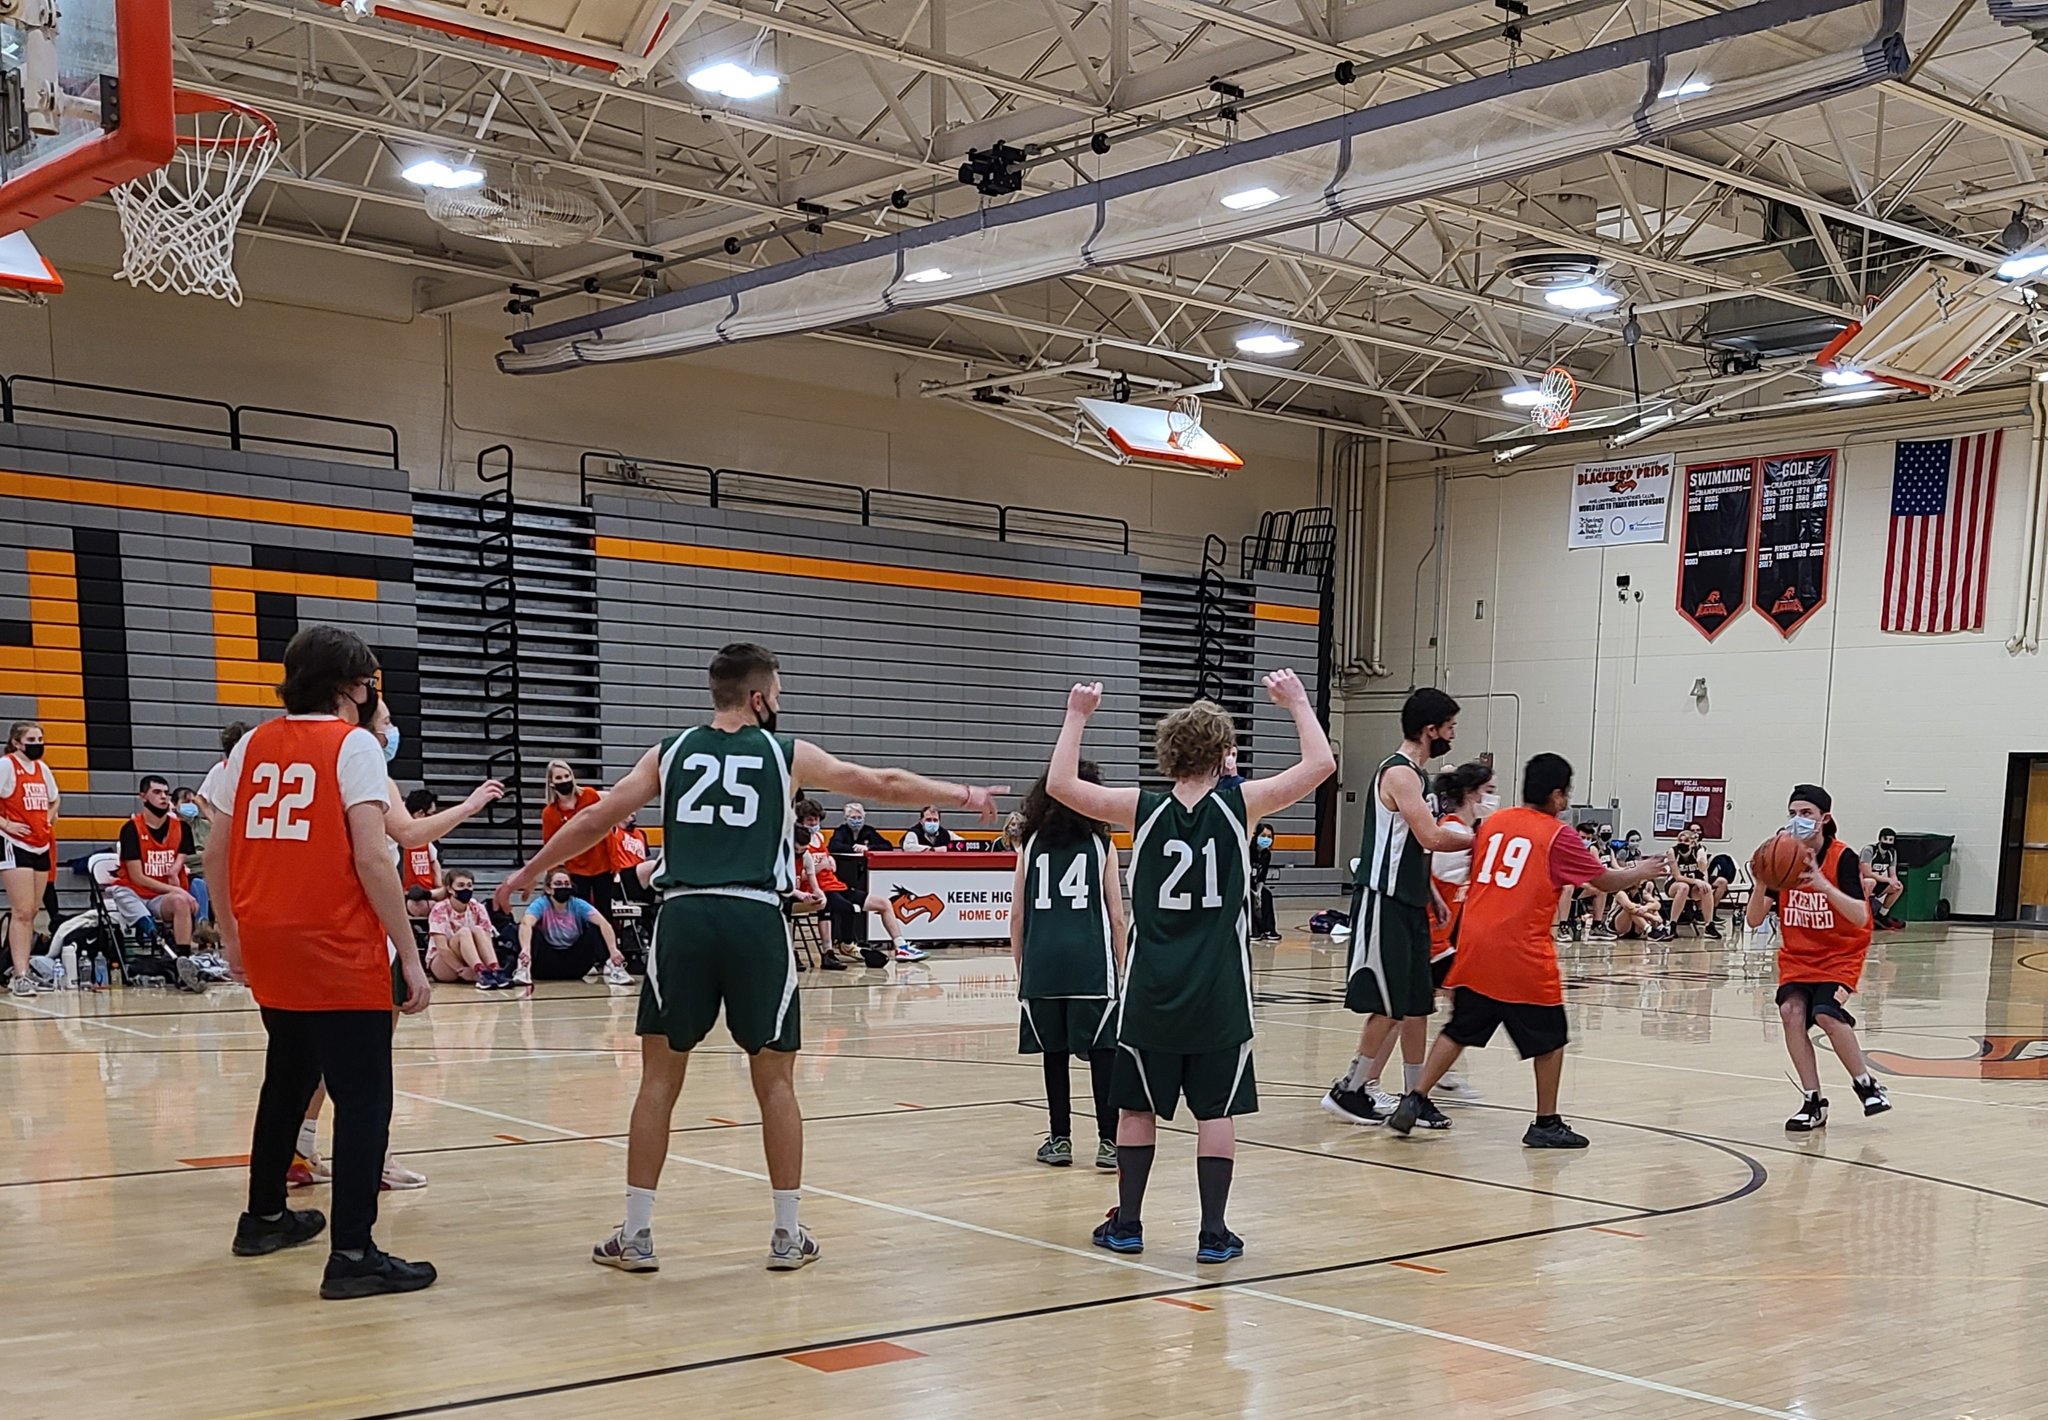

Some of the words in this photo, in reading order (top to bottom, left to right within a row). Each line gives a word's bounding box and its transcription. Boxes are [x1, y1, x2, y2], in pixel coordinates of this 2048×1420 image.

[1577, 470, 1633, 486] BLACKBIRD
[1636, 464, 1670, 479] PRIDE
[1689, 467, 1751, 487] SWIMMING
[1782, 461, 1814, 477] GOLF
[1695, 486, 1743, 496] CHAMPIONSHIPS
[1771, 478, 1822, 489] CHAMPIONSHIPS
[1639, 497, 1665, 507] SPONSORS
[1774, 543, 1810, 552] RUNNER-UP
[676, 753, 764, 828] 25
[245, 762, 317, 841] 22
[1476, 833, 1532, 889] 19
[1034, 853, 1089, 910] 14
[1158, 838, 1223, 910] 21
[947, 892, 987, 903] KEENE
[992, 892, 1012, 903] HIG
[959, 910, 991, 920] HOME
[995, 910, 1009, 920] OF
